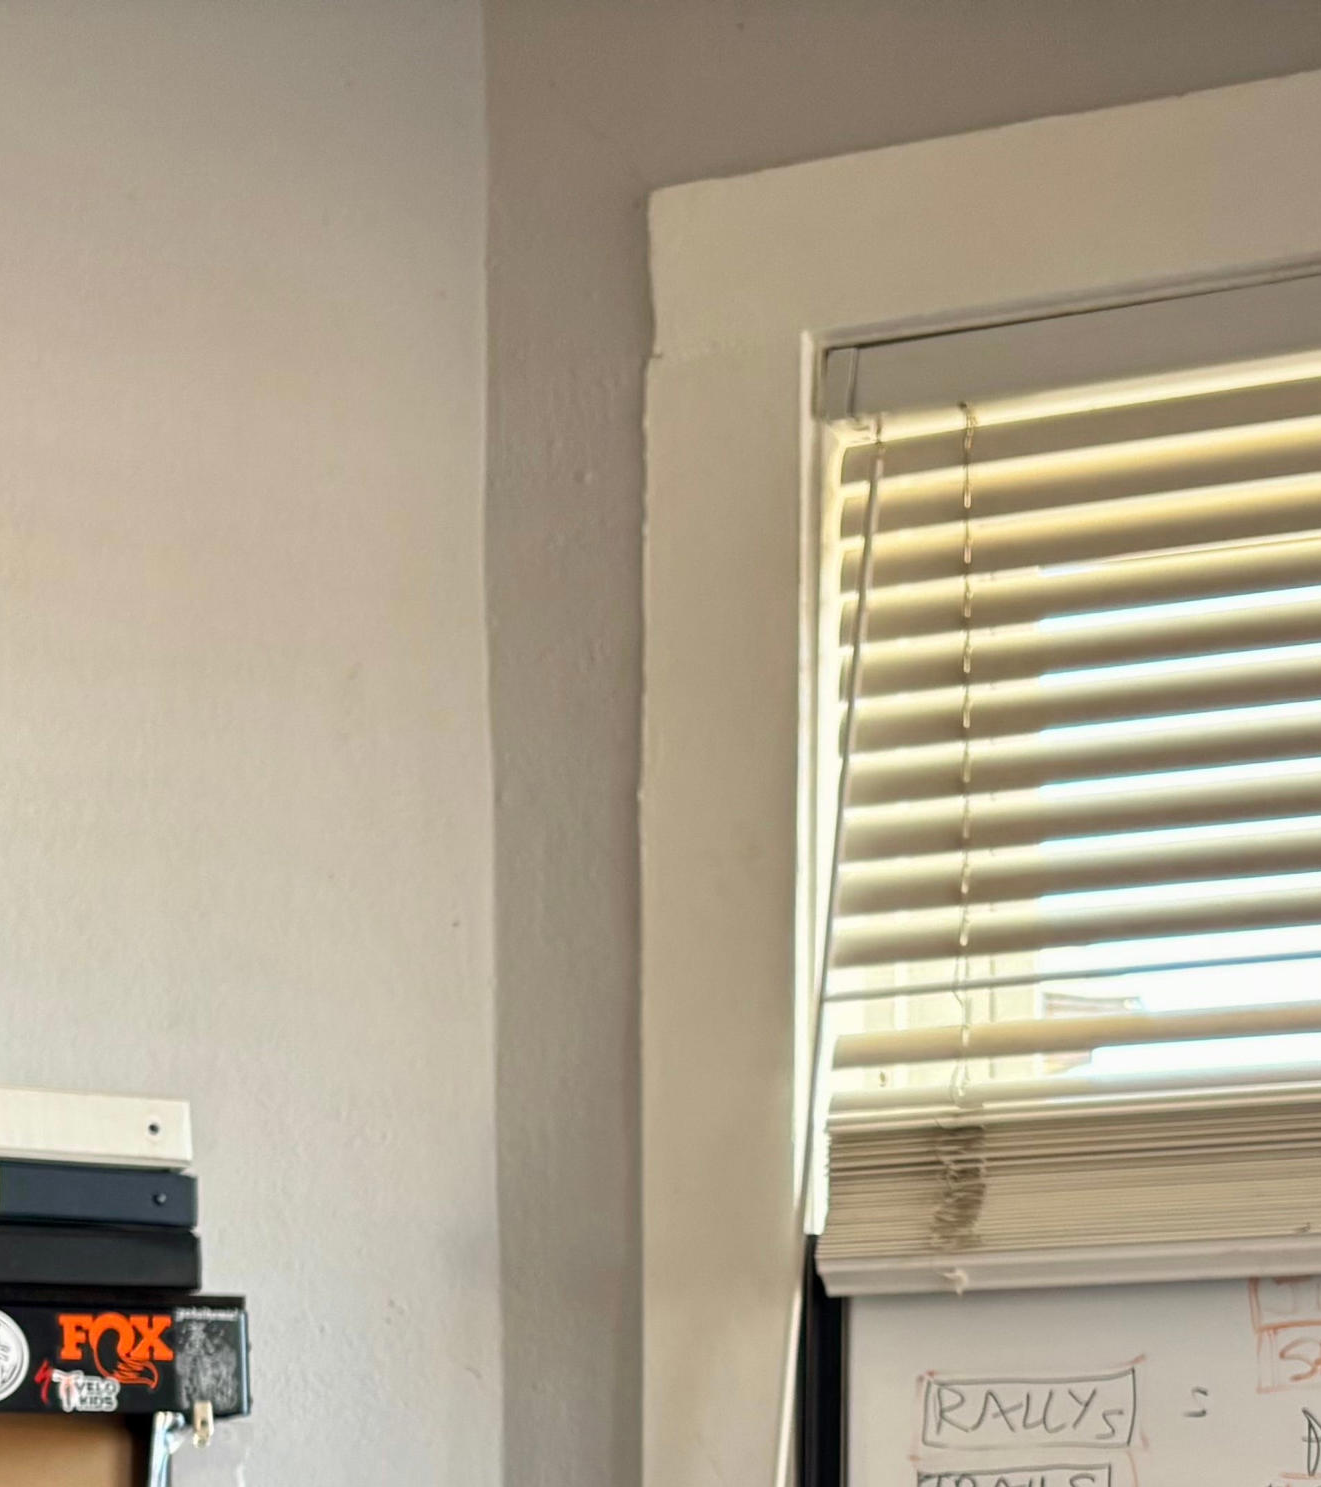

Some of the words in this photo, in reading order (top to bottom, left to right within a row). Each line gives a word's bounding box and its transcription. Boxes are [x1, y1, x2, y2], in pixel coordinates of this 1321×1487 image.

[58, 1312, 175, 1372] FOX
[76, 1380, 118, 1394] VELO
[78, 1395, 116, 1408] KIDS
